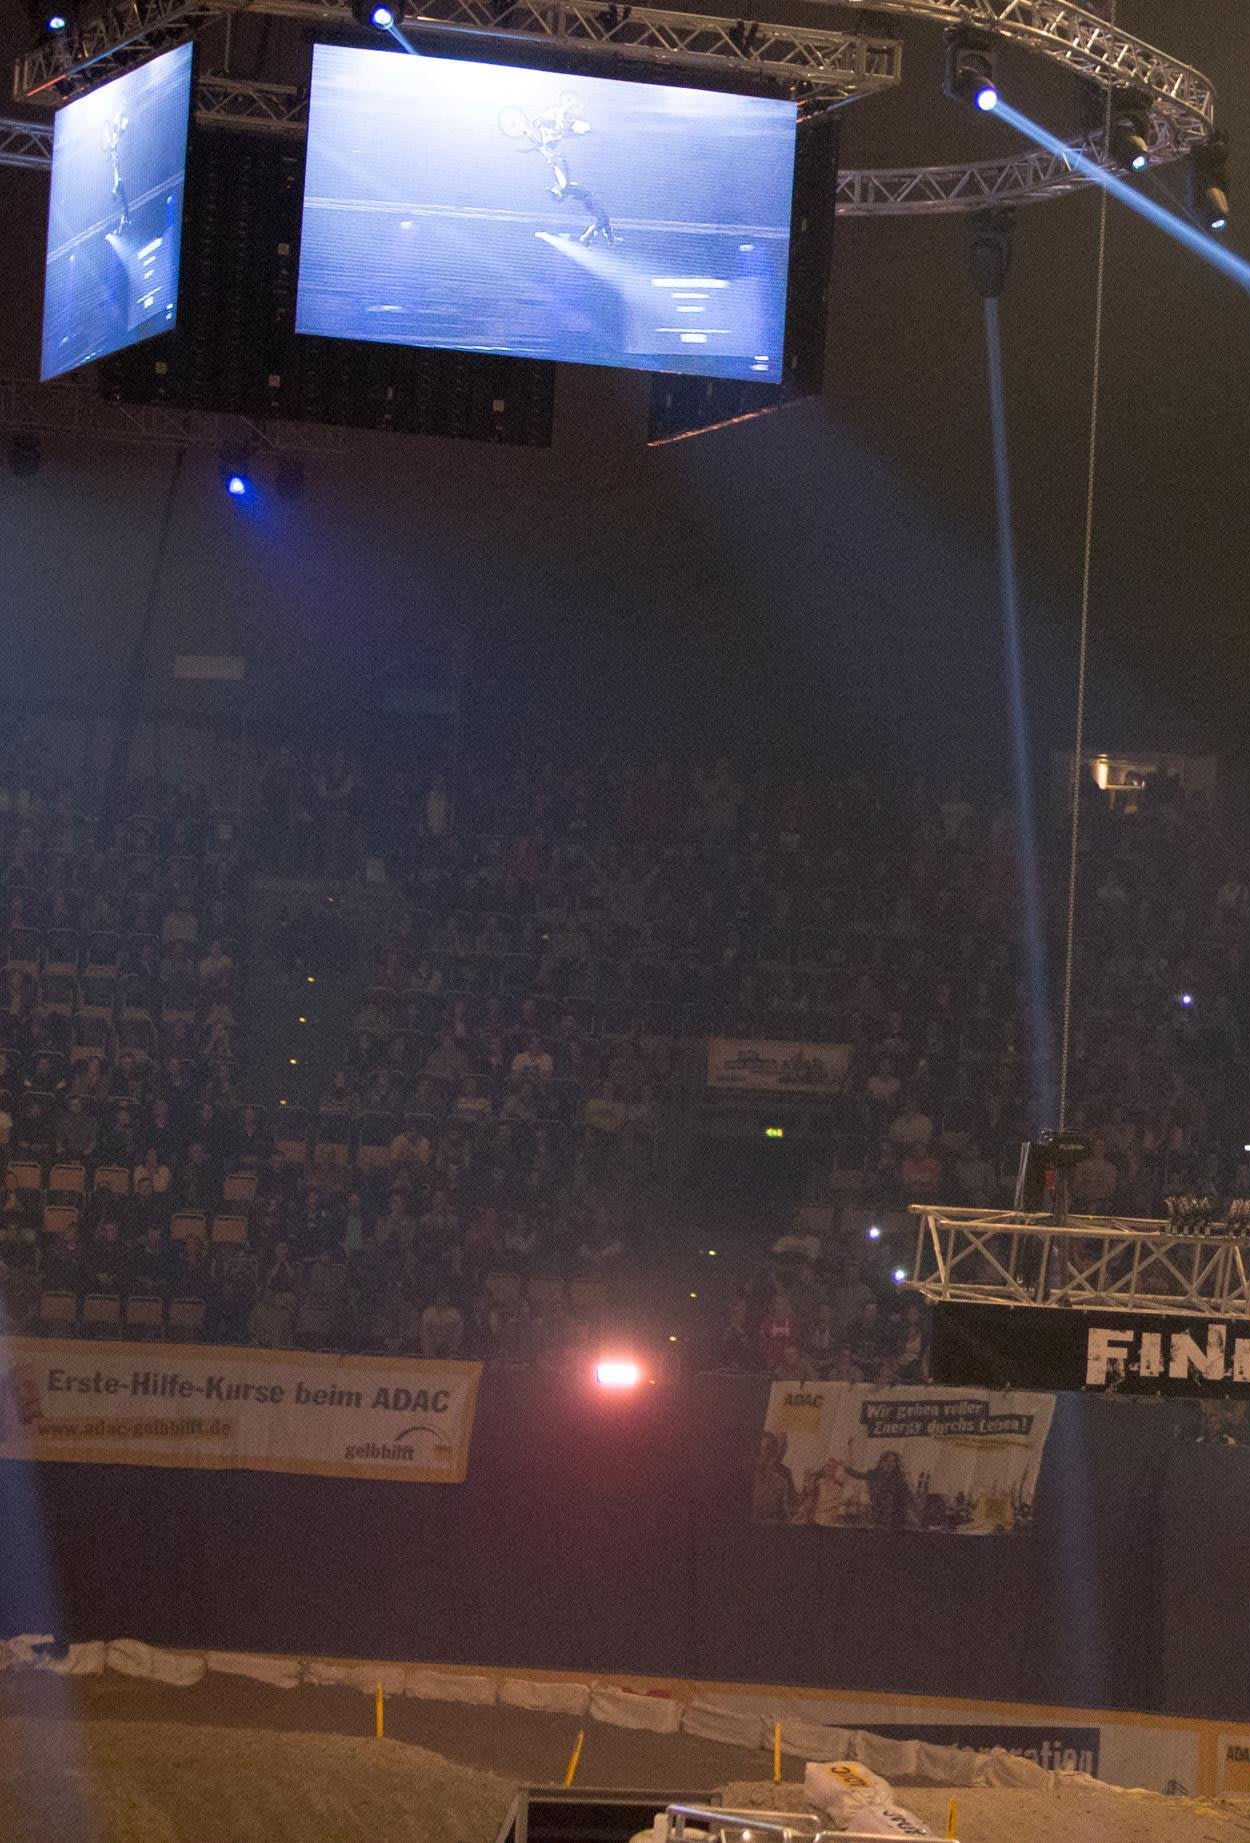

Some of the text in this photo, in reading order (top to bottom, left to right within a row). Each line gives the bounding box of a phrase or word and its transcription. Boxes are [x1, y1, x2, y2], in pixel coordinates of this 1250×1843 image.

[47, 1368, 449, 1413] Erste-Hilfe-Kurse beim ADAC
